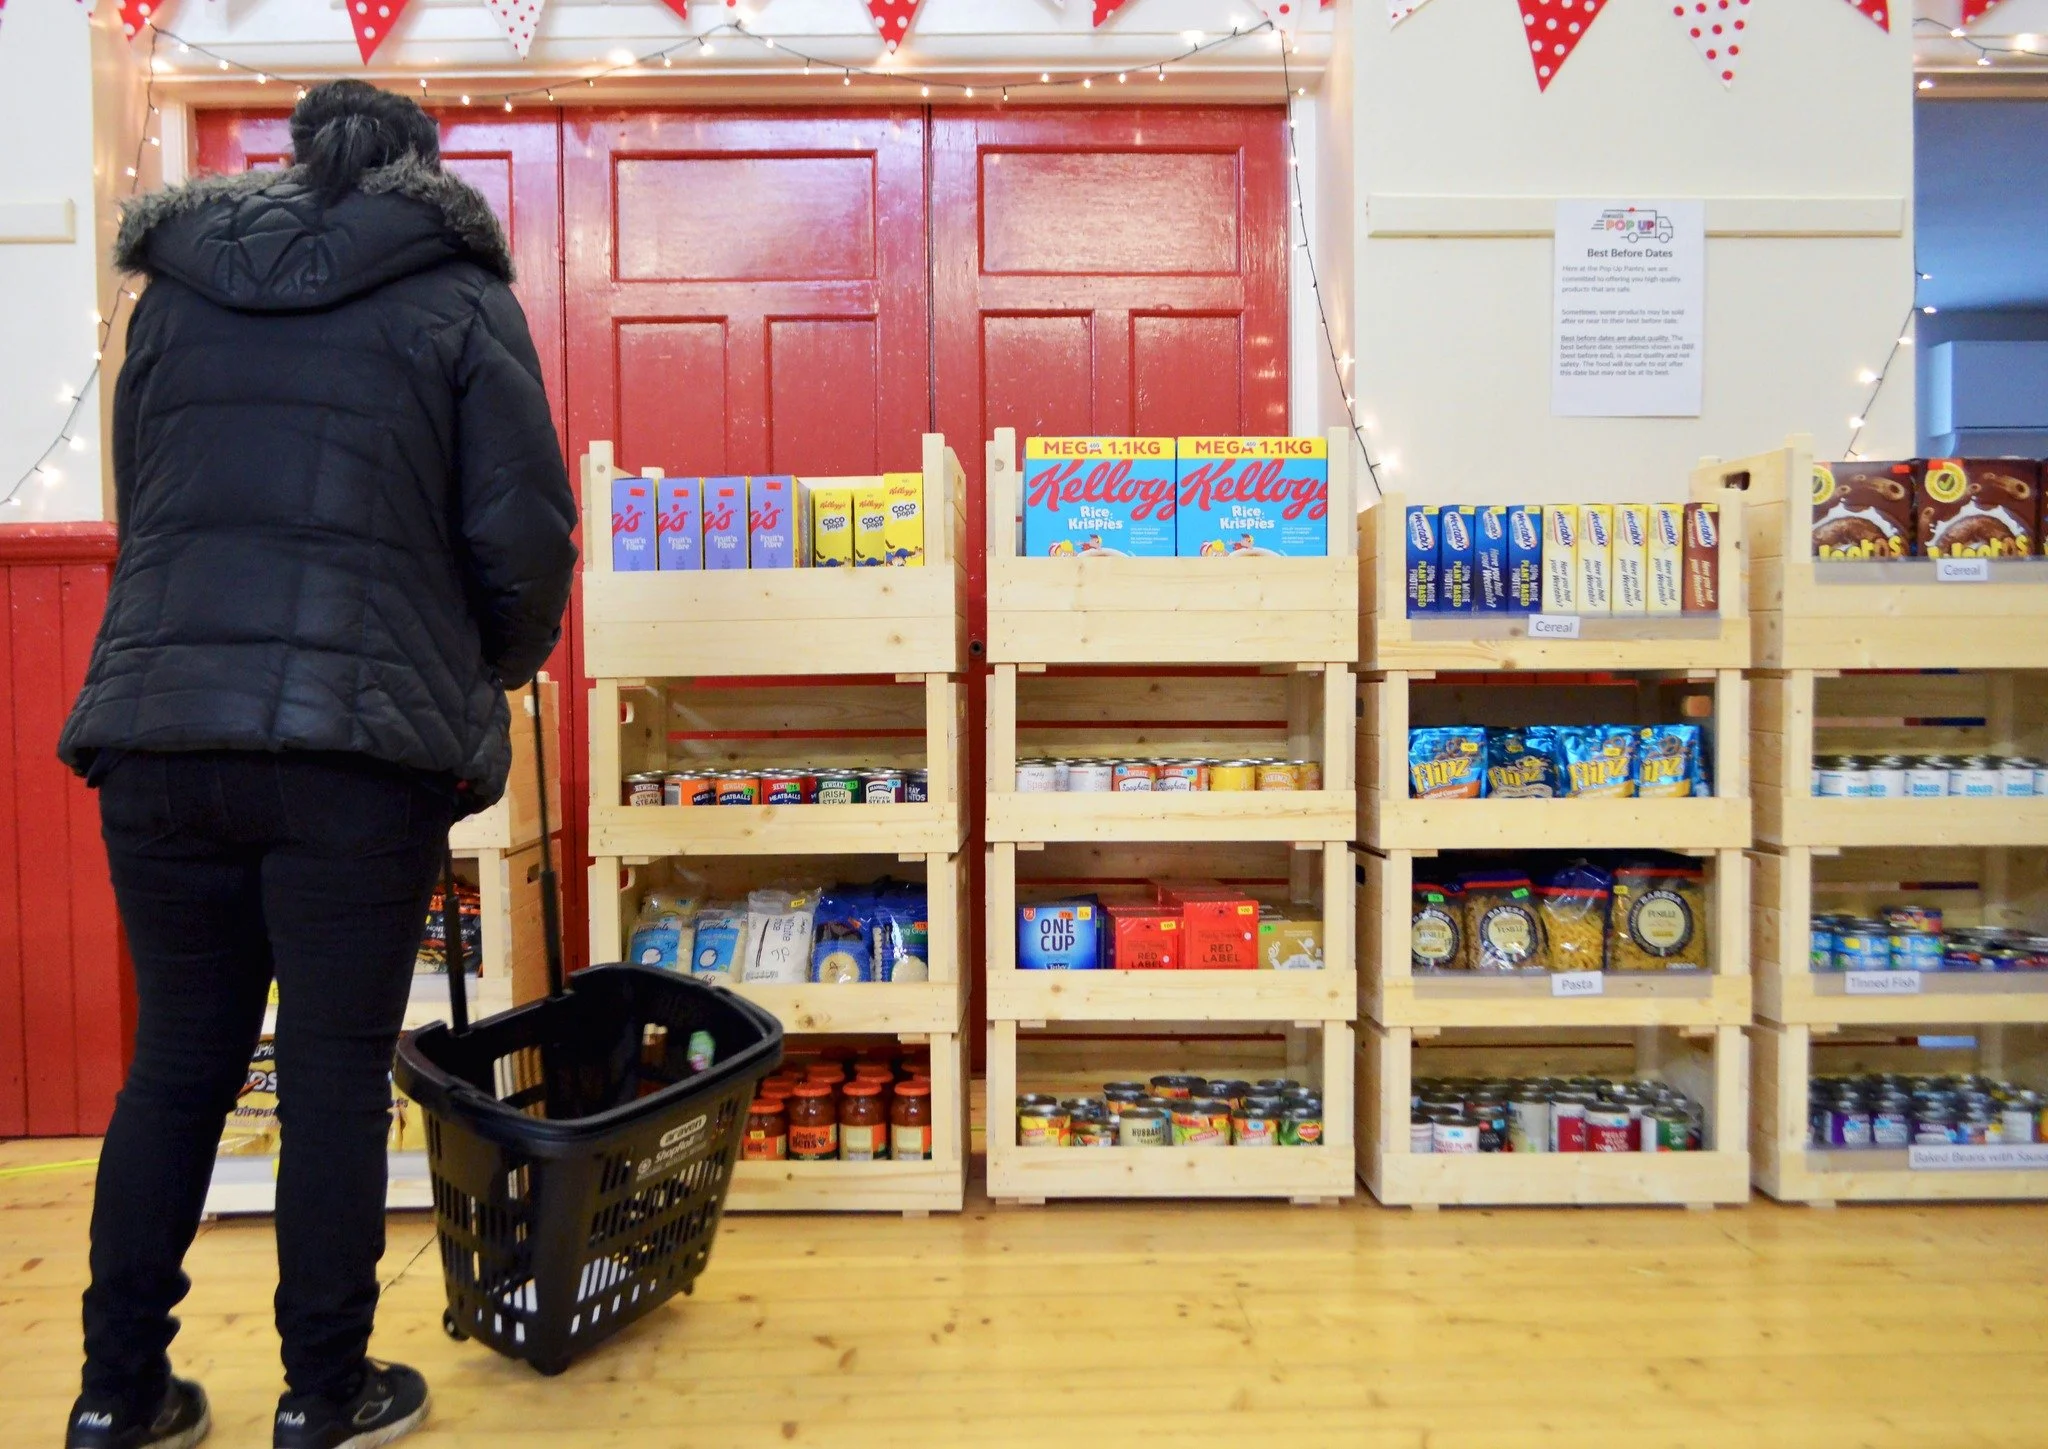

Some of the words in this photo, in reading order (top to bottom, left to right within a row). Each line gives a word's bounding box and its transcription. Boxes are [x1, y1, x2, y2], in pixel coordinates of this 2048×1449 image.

[1606, 220, 1634, 230] POP
[1638, 220, 1654, 230] UP
[1588, 248, 1608, 257] Best
[1611, 248, 1643, 257] Before
[1646, 248, 1673, 257] Dates
[1108, 441, 1160, 454] 1.1KG
[1260, 441, 1312, 454] 1.1KG
[1080, 505, 1110, 518] Rice
[1232, 505, 1262, 518] Rice
[1068, 518, 1124, 531] Krispies
[1220, 518, 1275, 530] Krispies
[1414, 513, 1430, 550] Weetabix
[1516, 513, 1532, 550] Weetabix
[1556, 511, 1574, 547] Weetabix
[1590, 511, 1607, 547] Weetabix
[1625, 511, 1642, 547] Weetabix
[1660, 510, 1678, 547] Weetabix
[1697, 510, 1714, 547] Weetabix
[1449, 514, 1465, 551] Weetabix
[1417, 561, 1426, 582] PLANT
[1452, 561, 1462, 582] PLANT
[1520, 560, 1530, 581] PLANT
[1944, 564, 1981, 576] Cereal
[1417, 585, 1426, 607] BASED
[1452, 585, 1462, 607] BASED
[1520, 584, 1530, 606] BASED
[1535, 620, 1573, 634] Cereal
[720, 793, 751, 801] MEATBALLS
[769, 793, 801, 801] MEATBALLS
[1040, 918, 1074, 934] ONE
[1040, 935, 1075, 951] CUP
[1210, 944, 1233, 953] RED
[1203, 954, 1239, 962] LABEL
[1561, 980, 1593, 991] Pasta
[1892, 976, 1915, 987] Fish
[1952, 1152, 1986, 1162] Beans
[78, 1411, 113, 1426] FILA
[278, 1411, 306, 1426] FILA
